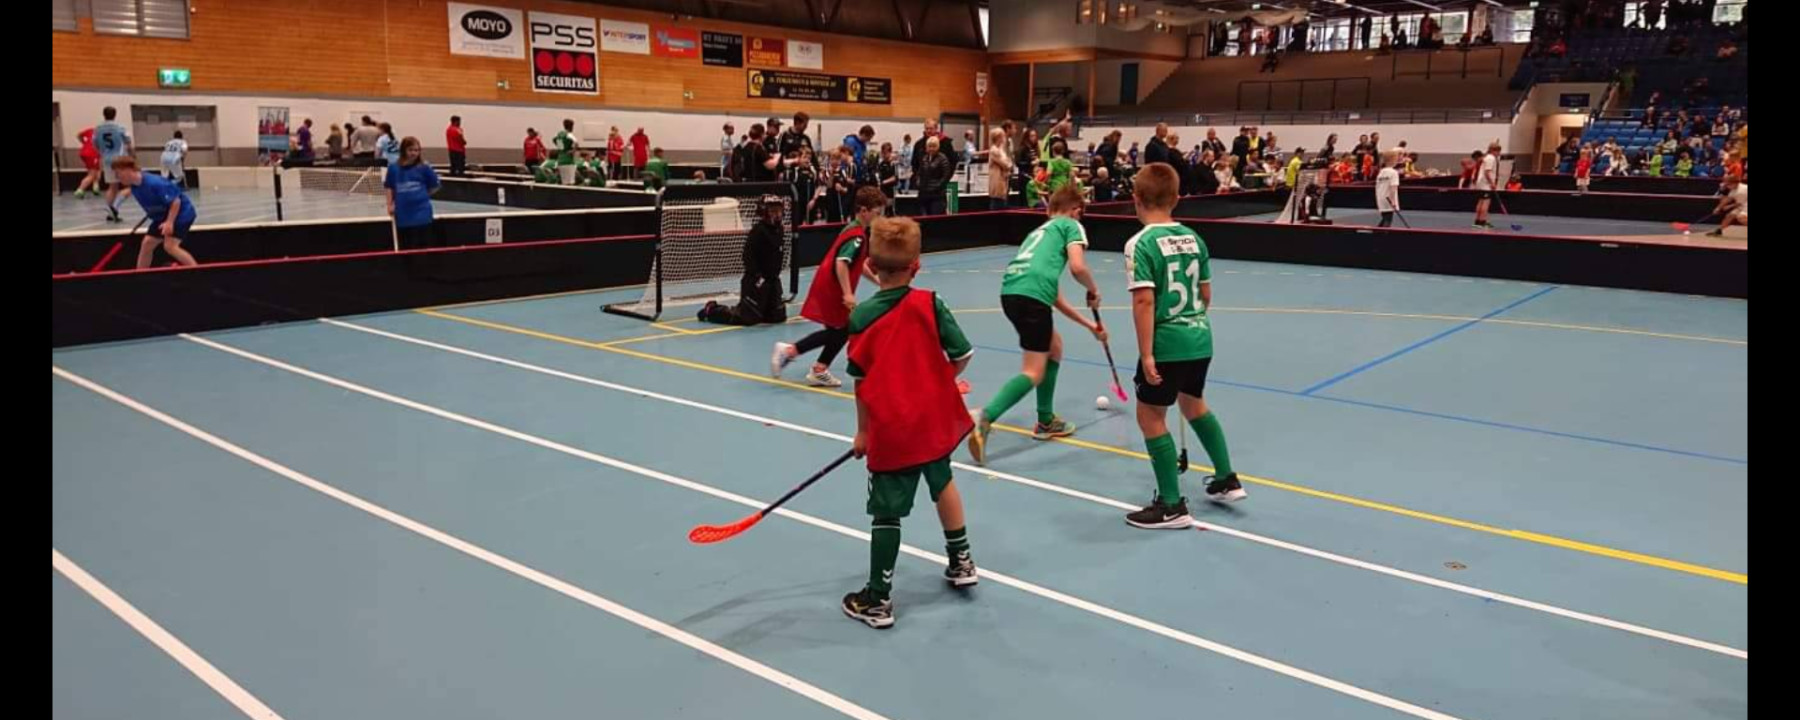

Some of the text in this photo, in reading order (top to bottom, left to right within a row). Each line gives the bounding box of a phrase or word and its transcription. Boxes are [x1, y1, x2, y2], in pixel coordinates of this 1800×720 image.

[467, 17, 507, 33] MOYO
[530, 22, 595, 48] PSS
[537, 75, 594, 89] SECURITAS
[102, 133, 114, 149] 5
[1167, 259, 1202, 316] 51
